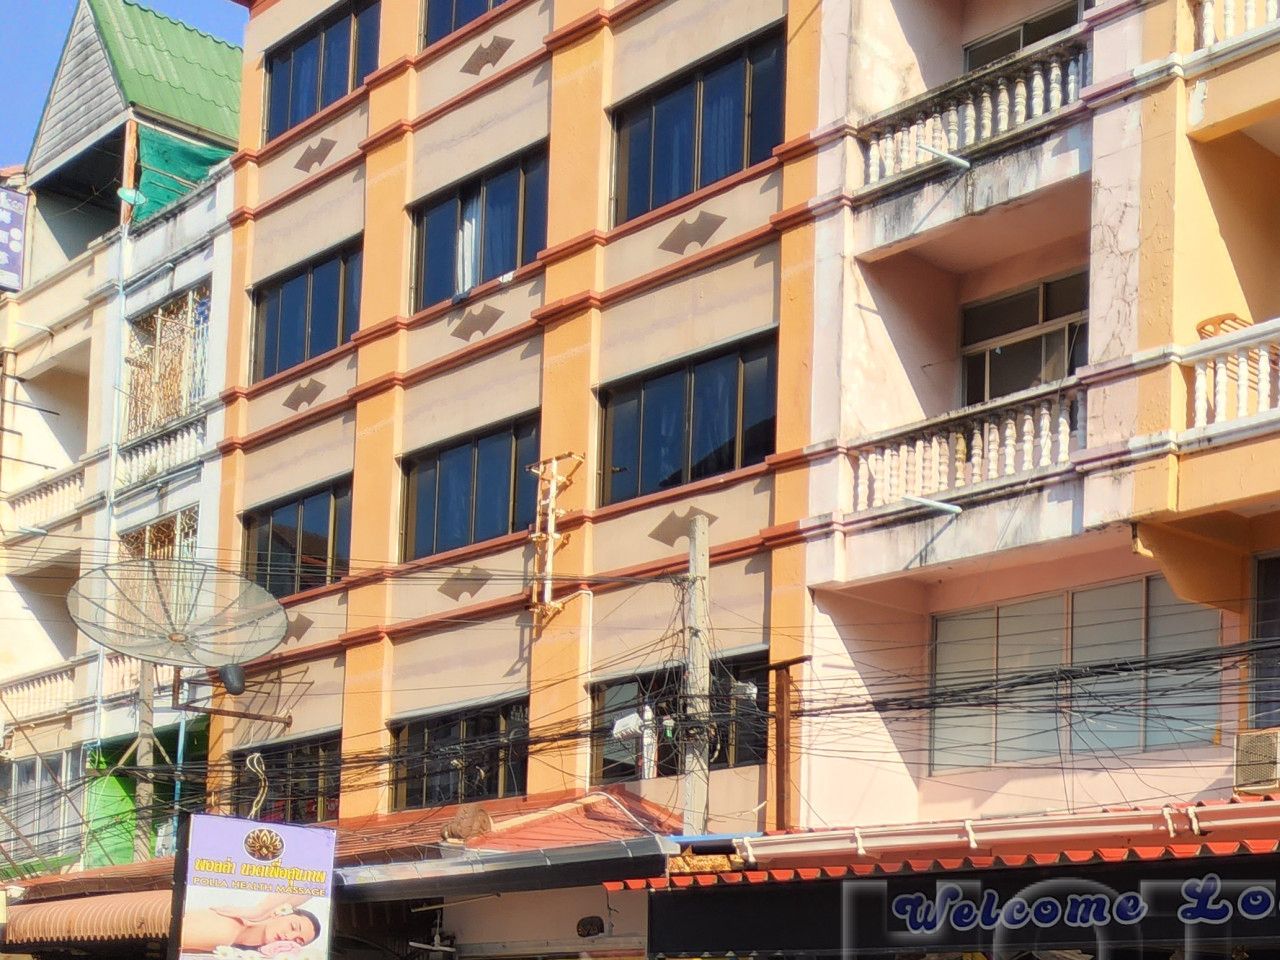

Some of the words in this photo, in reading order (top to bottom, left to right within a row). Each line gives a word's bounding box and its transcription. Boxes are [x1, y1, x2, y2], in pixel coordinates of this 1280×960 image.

[192, 877, 228, 888] POLLA
[231, 880, 273, 893] HEALTH
[275, 885, 326, 897] MASSAGE
[892, 883, 1149, 934] Welcome
